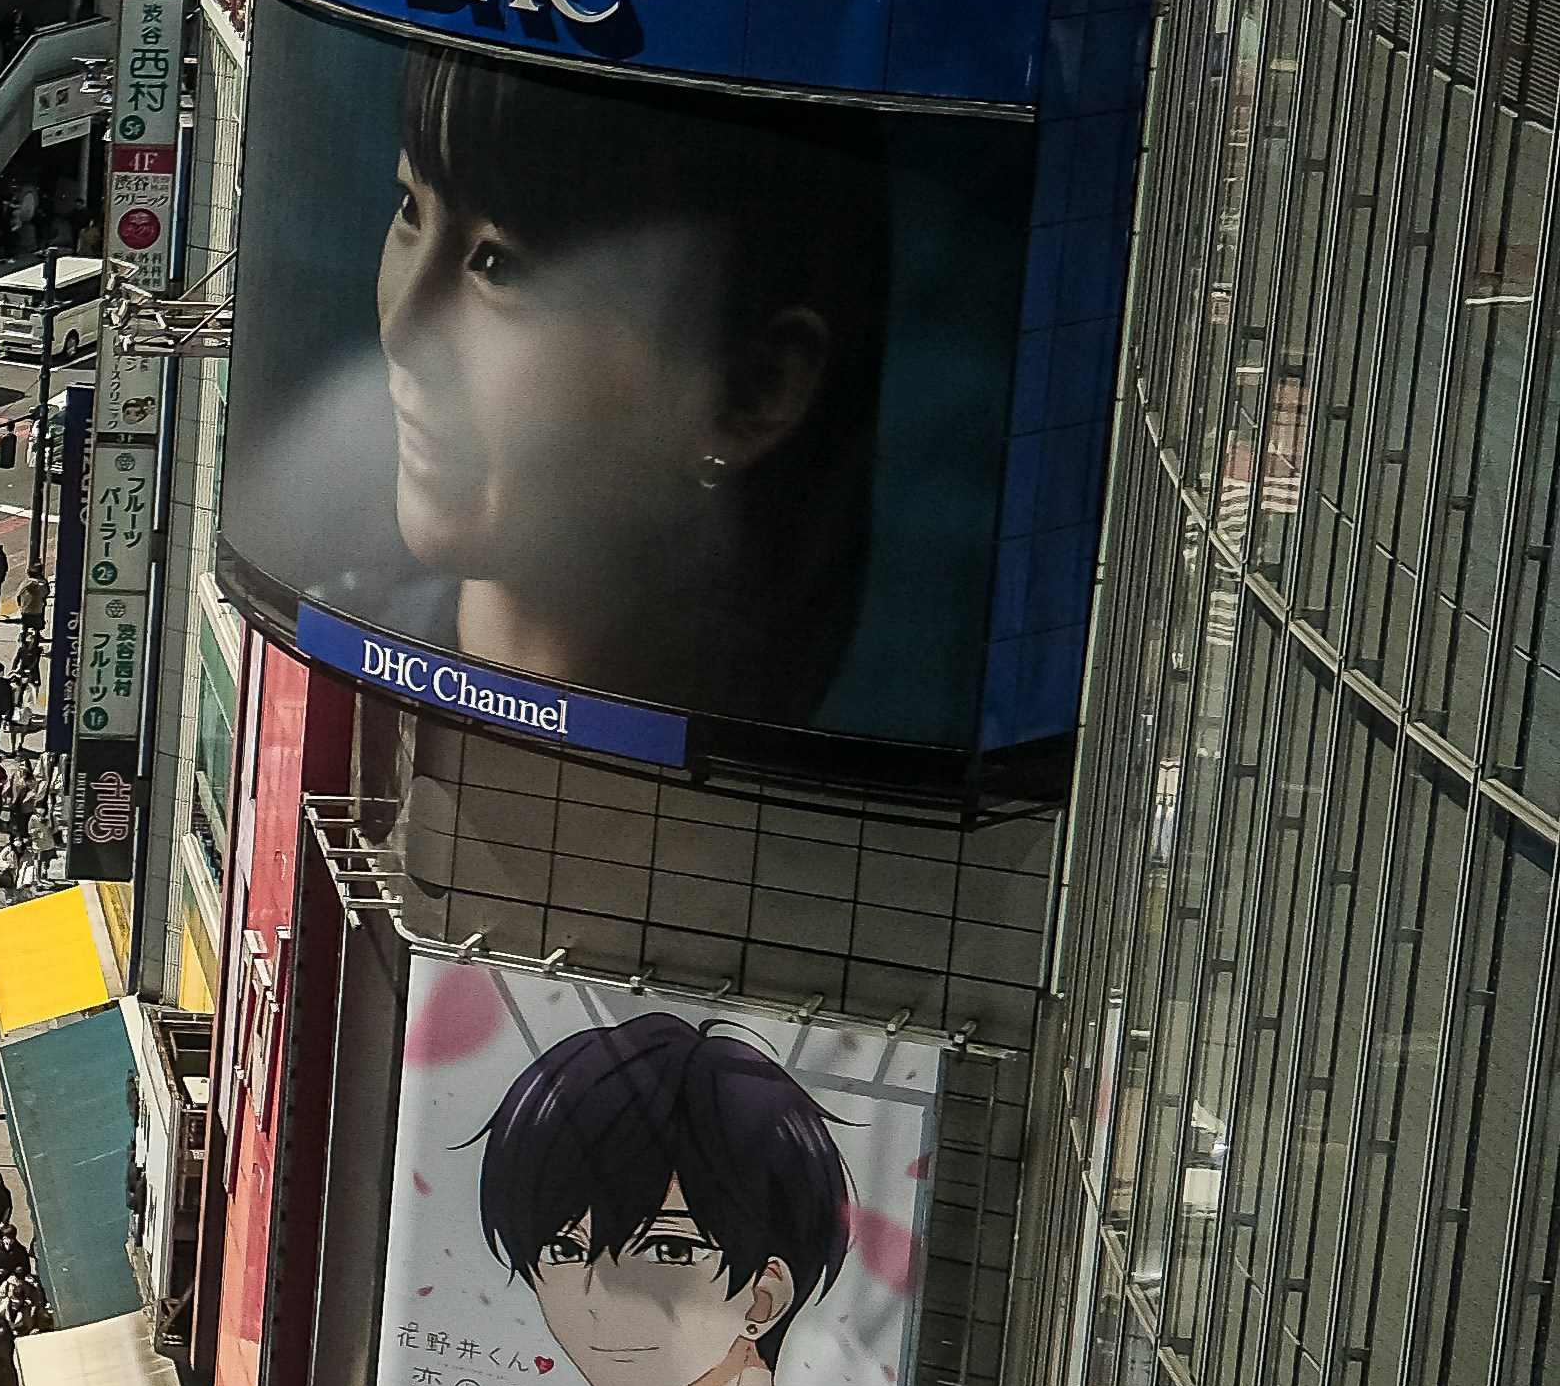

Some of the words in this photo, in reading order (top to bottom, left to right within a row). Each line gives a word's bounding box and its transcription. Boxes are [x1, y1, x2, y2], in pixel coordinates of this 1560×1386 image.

[128, 151, 159, 173] 4F
[98, 485, 120, 558] パーラー
[123, 476, 145, 549] フルーツ
[88, 631, 110, 704] フルーツ
[113, 623, 138, 699] 渋谷西村
[360, 637, 429, 696] DHC
[430, 663, 571, 737] Channel
[396, 1320, 531, 1377] 花野井くん
